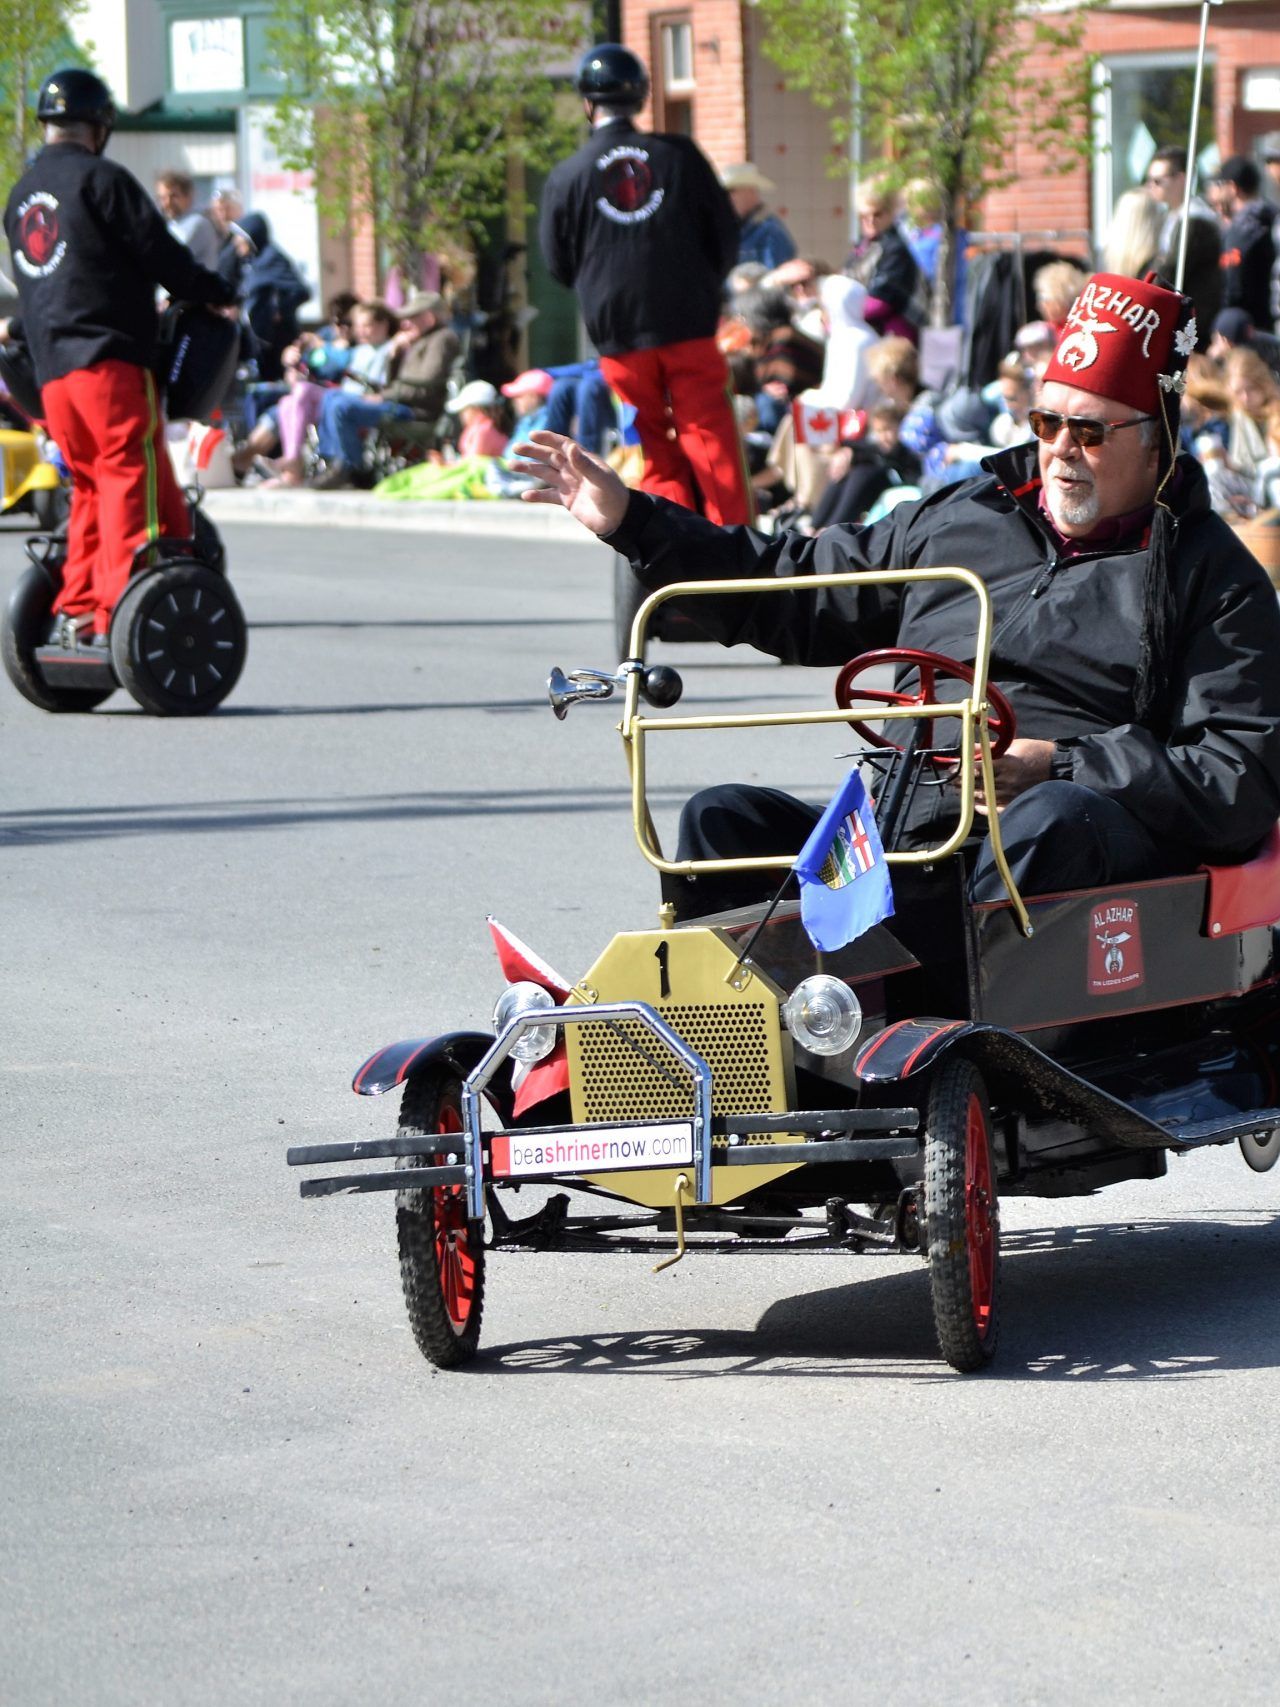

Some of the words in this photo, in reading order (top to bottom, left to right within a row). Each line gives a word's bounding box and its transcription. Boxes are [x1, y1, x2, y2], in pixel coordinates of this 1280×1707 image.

[1080, 282, 1161, 359] AZHAR
[1094, 912, 1106, 928] AL
[1106, 907, 1134, 923] AZHAR
[654, 940, 671, 999] 1
[513, 1136, 687, 1166] beashrinernow.com
